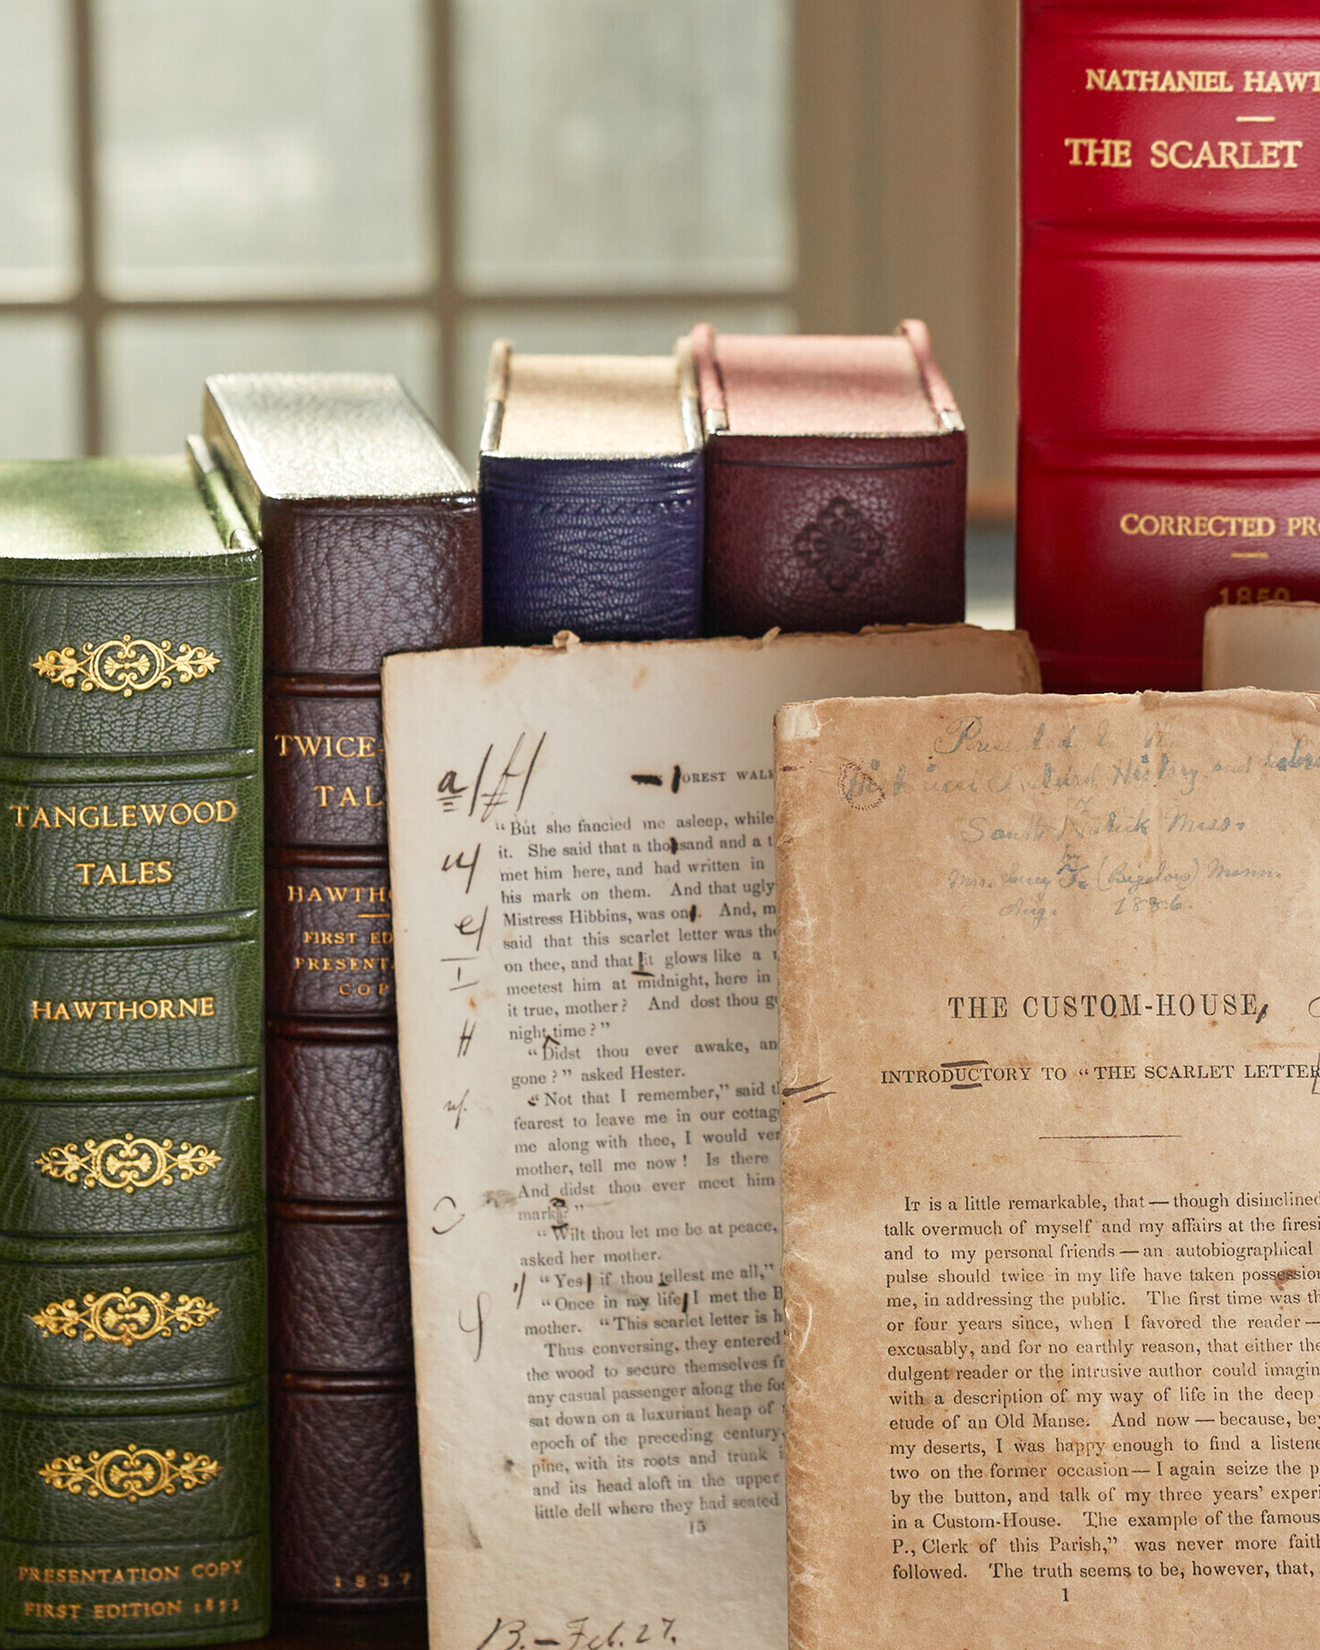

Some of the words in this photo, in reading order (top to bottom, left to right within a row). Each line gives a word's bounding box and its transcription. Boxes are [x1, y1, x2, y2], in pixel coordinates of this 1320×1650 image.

[1086, 69, 1234, 93] NATHANIEL
[1064, 138, 1132, 168] THE
[1151, 140, 1303, 169] SCARLET
[1121, 513, 1275, 537] CORRECTED
[680, 770, 728, 785] OREST
[10, 800, 238, 829] TANGLEWOOD
[546, 819, 572, 835] she
[577, 816, 632, 834] fancied
[642, 819, 666, 830] me
[676, 813, 729, 831] asleep,
[734, 807, 776, 827] while
[75, 860, 172, 886] TALES
[287, 886, 392, 903] HAWTH
[304, 931, 357, 945] FIRST
[296, 957, 395, 971] PRESENT
[32, 996, 215, 1021] HAWTHORNE
[947, 996, 1008, 1019] THE
[880, 1066, 1033, 1085] INTRODUCTORY
[1040, 1066, 1068, 1082] TO
[1144, 1064, 1235, 1080] SCARLET
[883, 1221, 915, 1237] talk
[921, 1220, 1003, 1237] overmuch
[1009, 1218, 1028, 1235] of
[1035, 1218, 1093, 1239] myself
[1101, 1217, 1132, 1234] and
[1139, 1222, 1165, 1238] my
[1171, 1217, 1223, 1233] affairs
[1228, 1219, 1244, 1233] at
[1250, 1216, 1276, 1232] the
[889, 1444, 917, 1460] my
[923, 1439, 987, 1458] deserts,
[996, 1437, 1003, 1454] I
[1013, 1442, 1046, 1453] was
[1055, 1437, 1106, 1457] happy
[1112, 1436, 1174, 1457] enough
[1183, 1437, 1199, 1451] to
[1209, 1434, 1241, 1451] find
[1250, 1439, 1261, 1451] a
[534, 1503, 569, 1521] little
[573, 1501, 602, 1518] dell
[607, 1500, 655, 1516] where
[659, 1497, 694, 1517] they
[699, 1493, 727, 1512] had
[732, 1490, 781, 1509] seated
[921, 1538, 969, 1555] Clerk
[978, 1537, 998, 1555] of
[1009, 1536, 1039, 1553] this
[1134, 1540, 1166, 1553] was
[1176, 1539, 1224, 1552] never
[1235, 1538, 1277, 1551] more
[19, 1565, 179, 1584] PRESENTATION
[192, 1559, 242, 1578] COPY
[892, 1563, 968, 1580] followed.
[988, 1562, 1024, 1579] The
[1032, 1561, 1073, 1578] truth
[1079, 1566, 1132, 1579] seems
[1137, 1564, 1153, 1578] to
[1159, 1561, 1185, 1580] be,
[1191, 1560, 1270, 1578] however,
[1275, 1558, 1315, 1578] that,
[1061, 1587, 1069, 1603] 1
[25, 1602, 81, 1619] FIRST
[94, 1599, 181, 1619] EDITION
